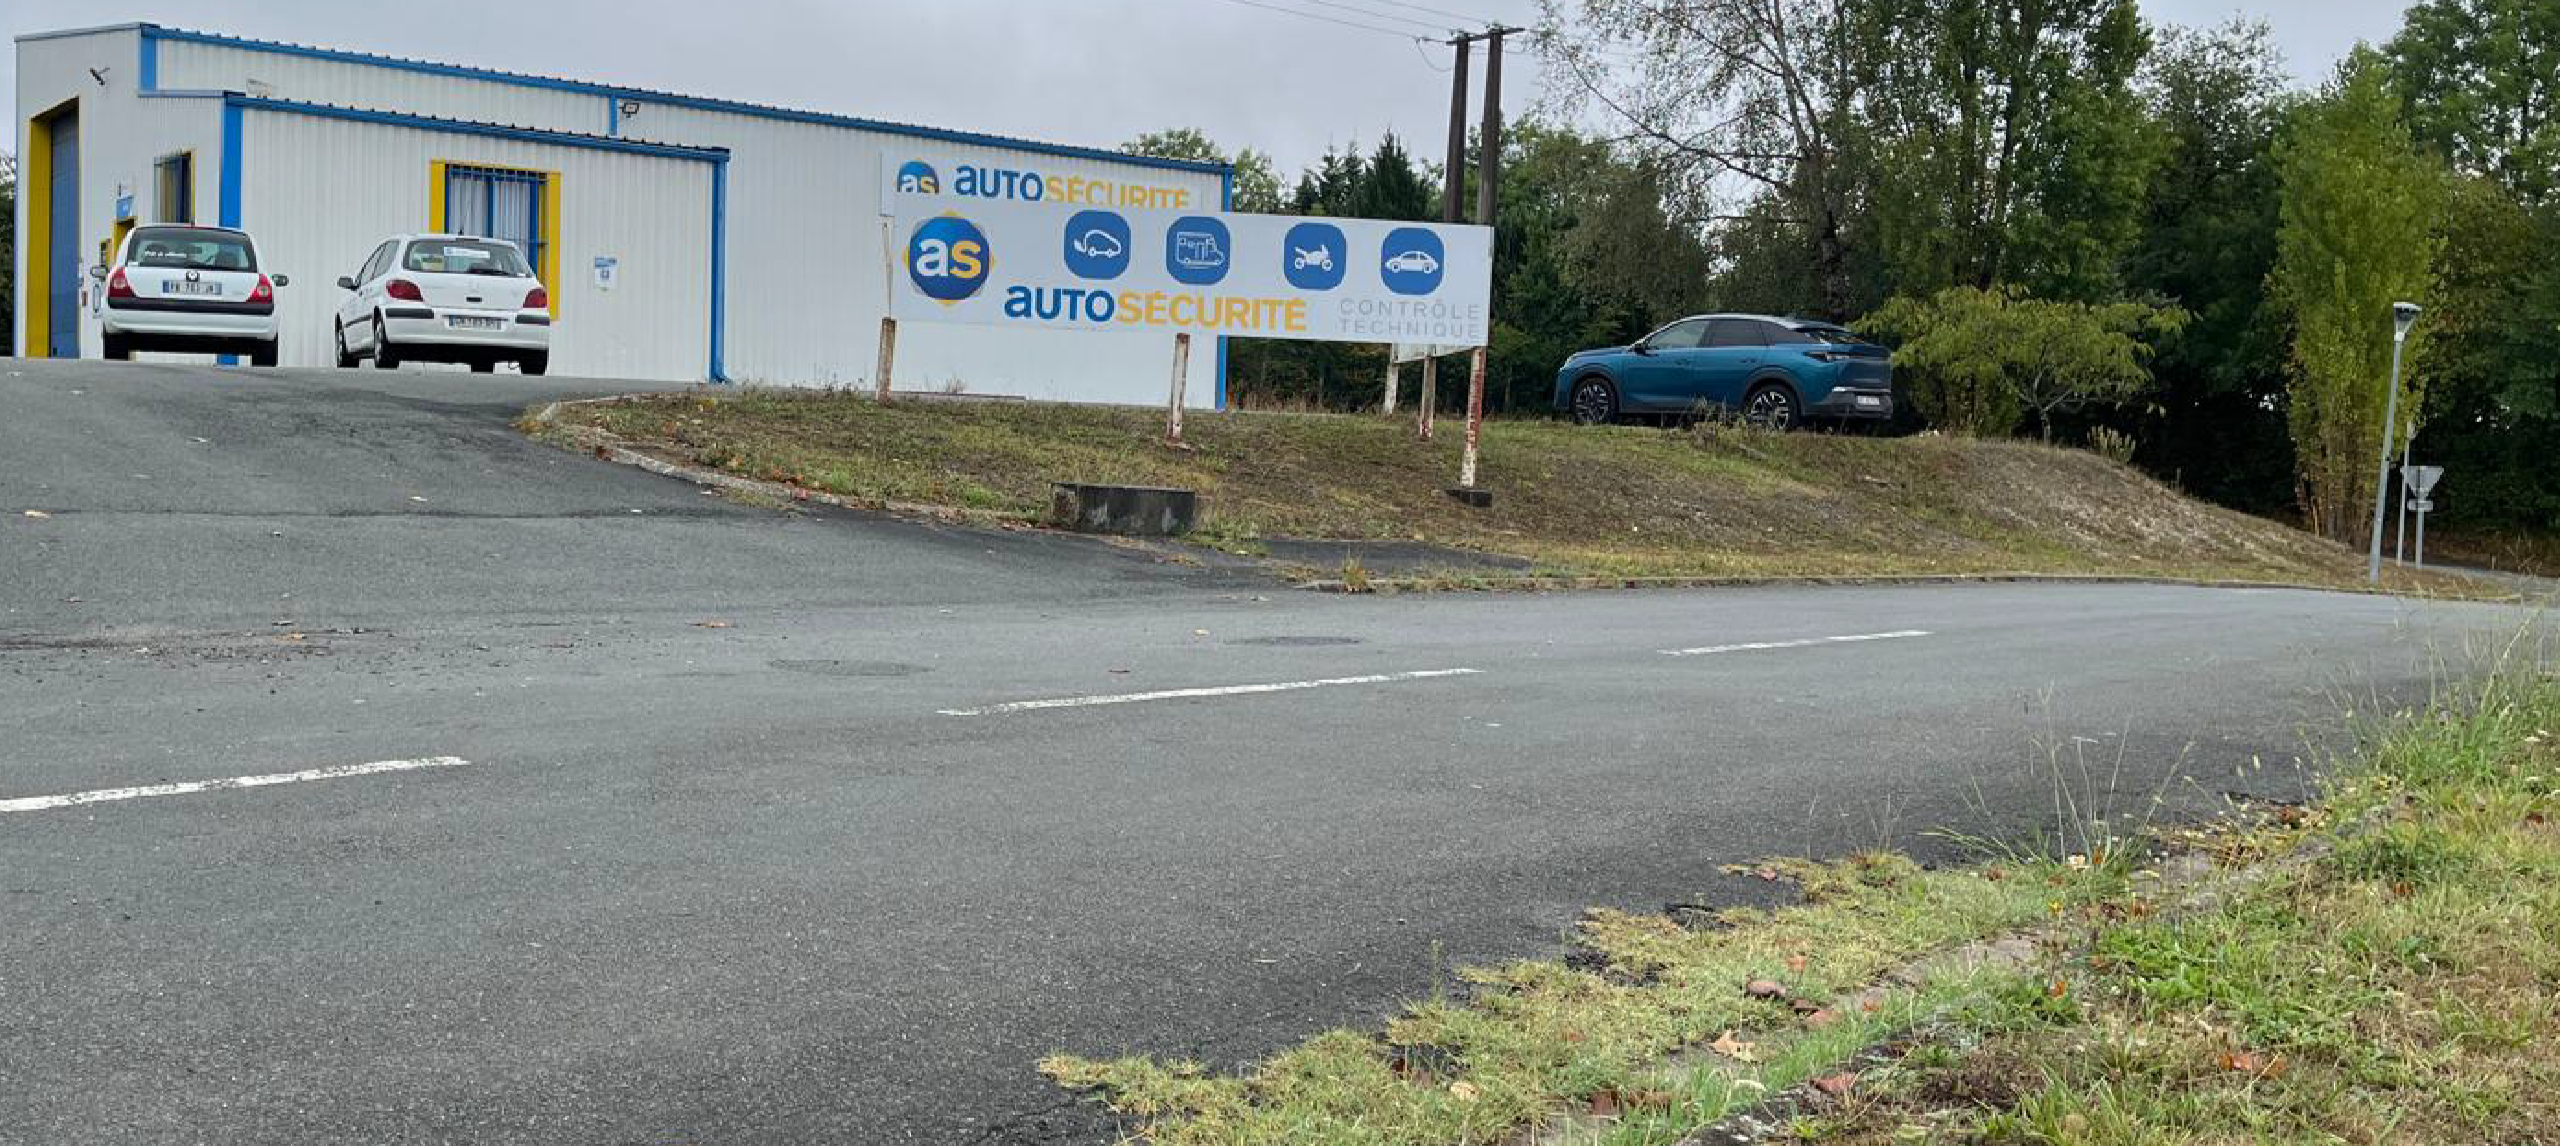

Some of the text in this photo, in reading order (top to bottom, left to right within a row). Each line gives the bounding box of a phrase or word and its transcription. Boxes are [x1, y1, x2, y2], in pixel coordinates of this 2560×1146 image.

[915, 239, 981, 278] as
[1340, 298, 1480, 320] CONTRÔLE
[1339, 318, 1480, 340] TECHNIQUE
